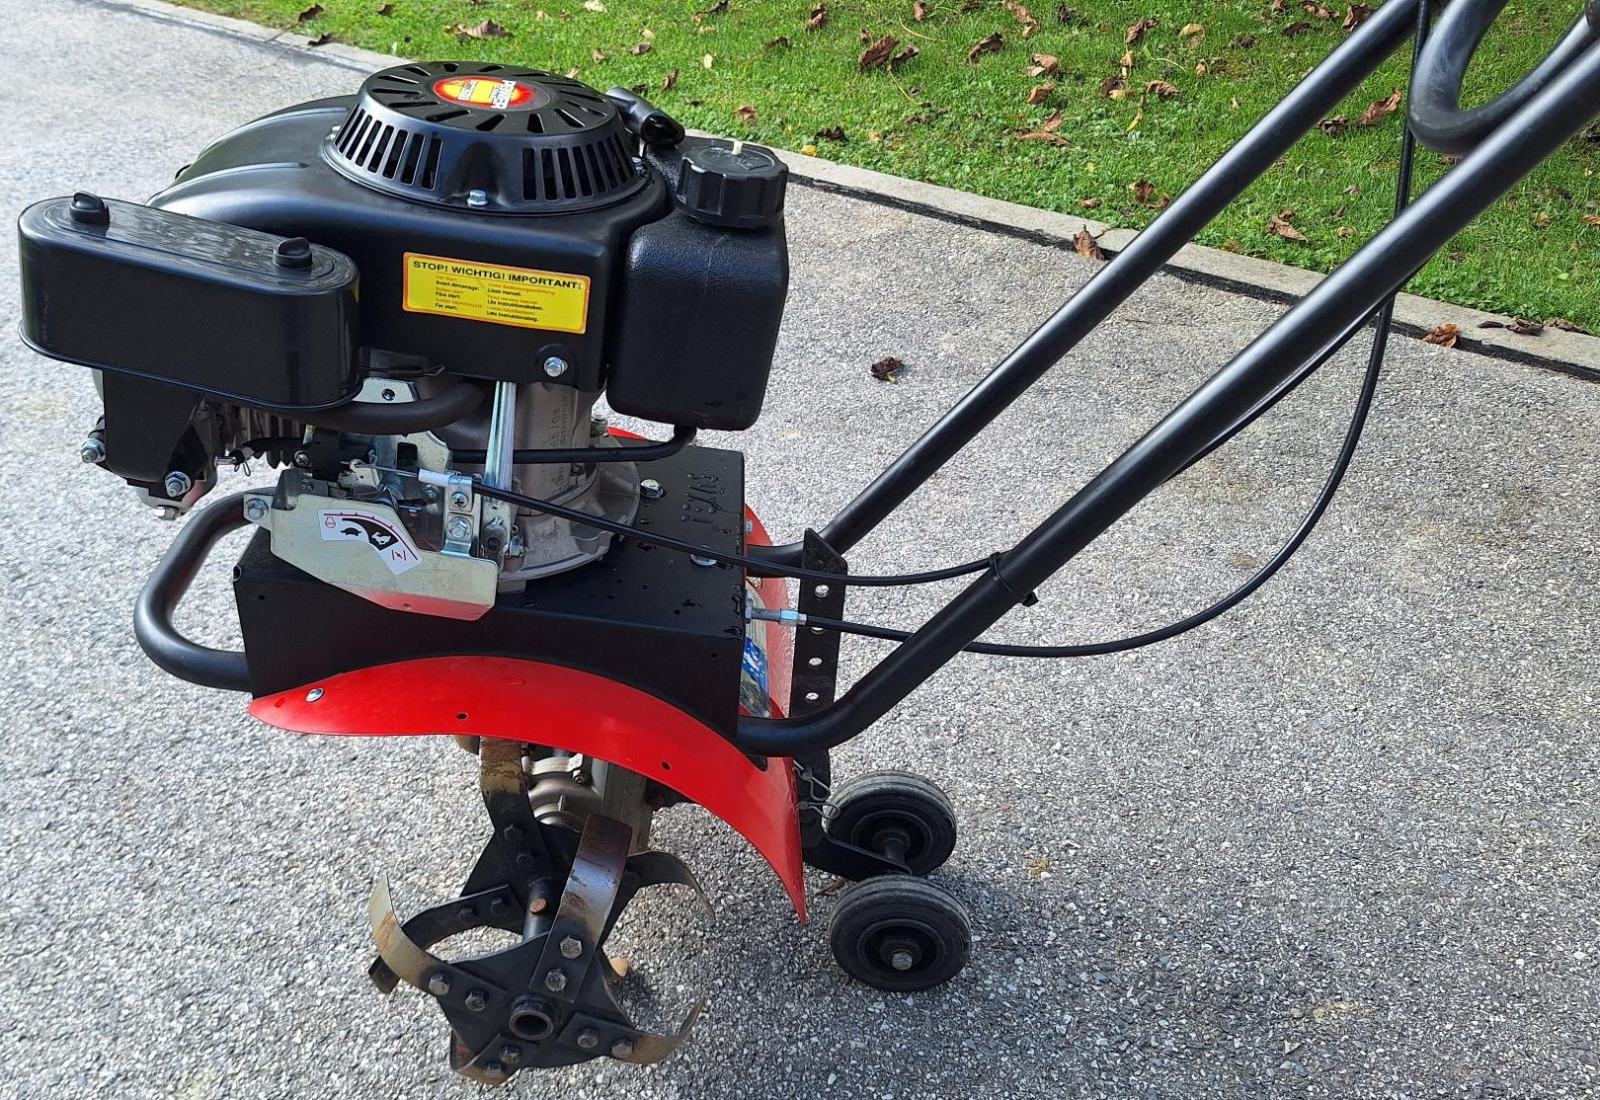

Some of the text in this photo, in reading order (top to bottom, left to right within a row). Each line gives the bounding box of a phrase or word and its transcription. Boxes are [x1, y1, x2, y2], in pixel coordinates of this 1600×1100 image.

[413, 260, 448, 272] STOP!
[451, 266, 505, 279] WICHTIG!
[508, 274, 582, 289] IMPORTANT!
